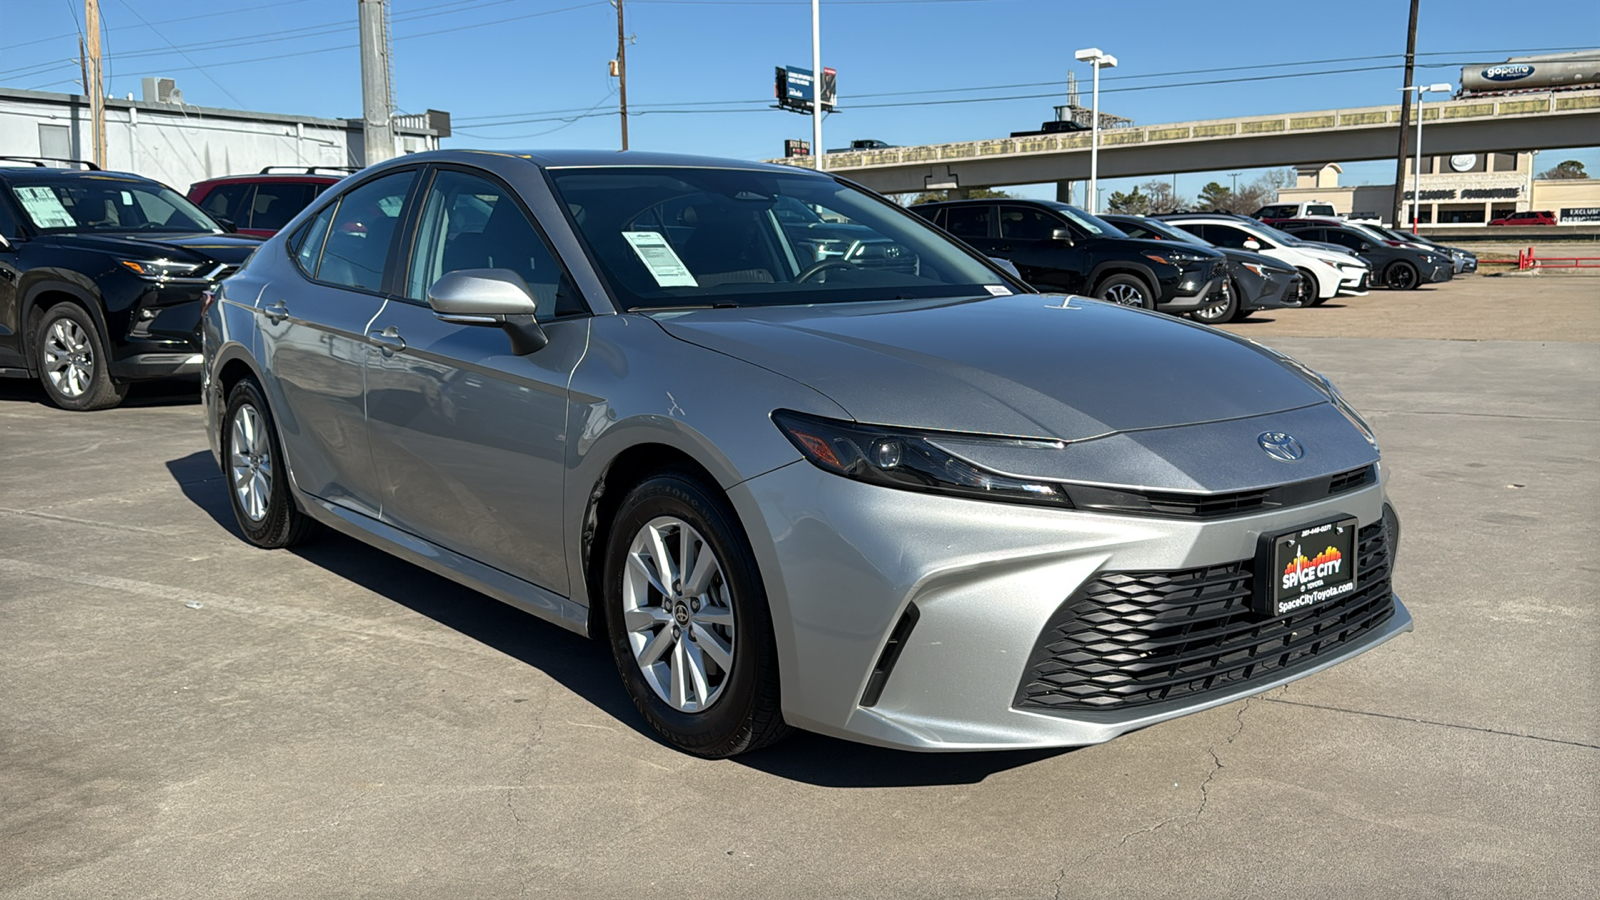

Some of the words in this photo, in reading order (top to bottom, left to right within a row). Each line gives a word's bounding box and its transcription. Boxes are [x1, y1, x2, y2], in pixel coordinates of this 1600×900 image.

[1487, 65, 1529, 78] gopetro
[1282, 565, 1316, 589] SPACE
[1317, 559, 1342, 578] CITY
[1306, 579, 1325, 589] TOYOTA
[1278, 582, 1354, 613] SpaceCityToyota.com
